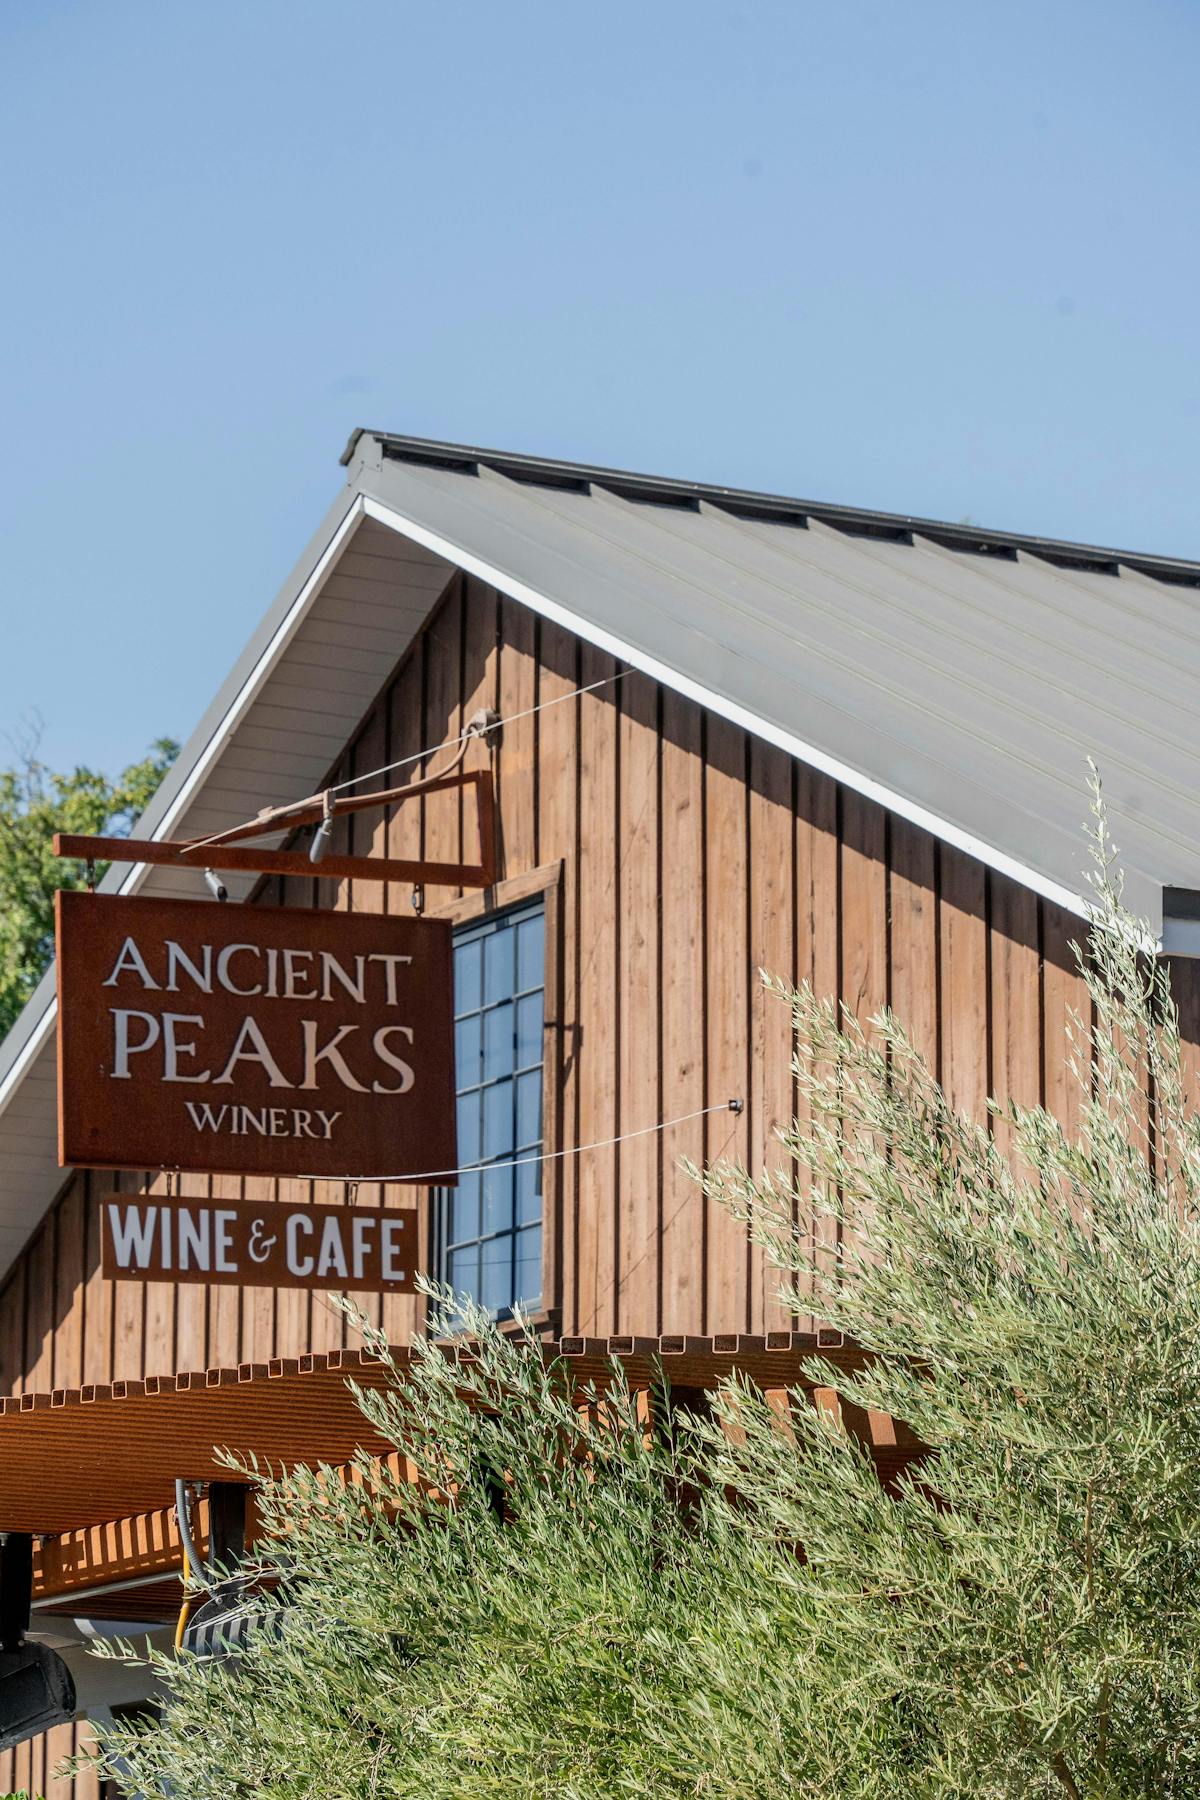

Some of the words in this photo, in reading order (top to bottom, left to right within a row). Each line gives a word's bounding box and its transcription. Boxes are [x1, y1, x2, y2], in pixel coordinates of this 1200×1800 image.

[101, 936, 412, 1006] ANCIENT
[109, 1008, 415, 1095] PEAKS
[184, 1101, 342, 1140] WINERY
[108, 1203, 239, 1273] WINE
[248, 1218, 276, 1263] &
[286, 1213, 405, 1281] CAFE
